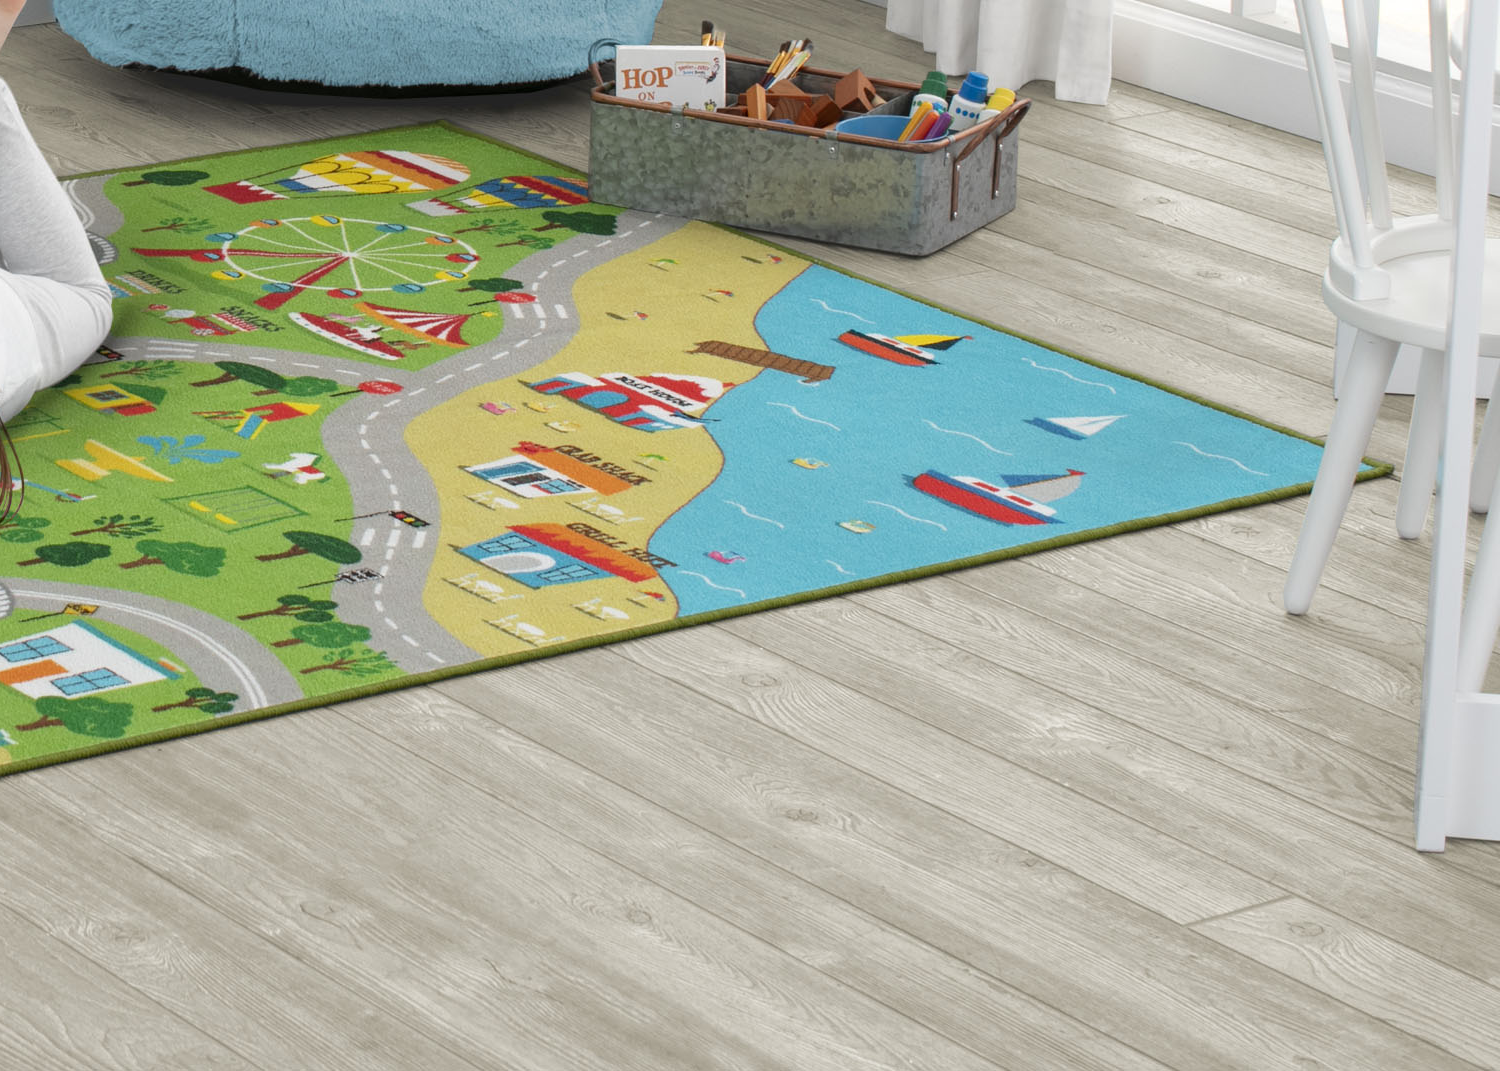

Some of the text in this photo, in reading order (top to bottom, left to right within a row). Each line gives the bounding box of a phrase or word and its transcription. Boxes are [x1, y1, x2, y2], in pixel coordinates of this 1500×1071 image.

[620, 66, 673, 90] HOP
[637, 90, 655, 102] ON
[553, 444, 653, 486] CRAB SHACK
[566, 522, 678, 570] GRILL HUT
